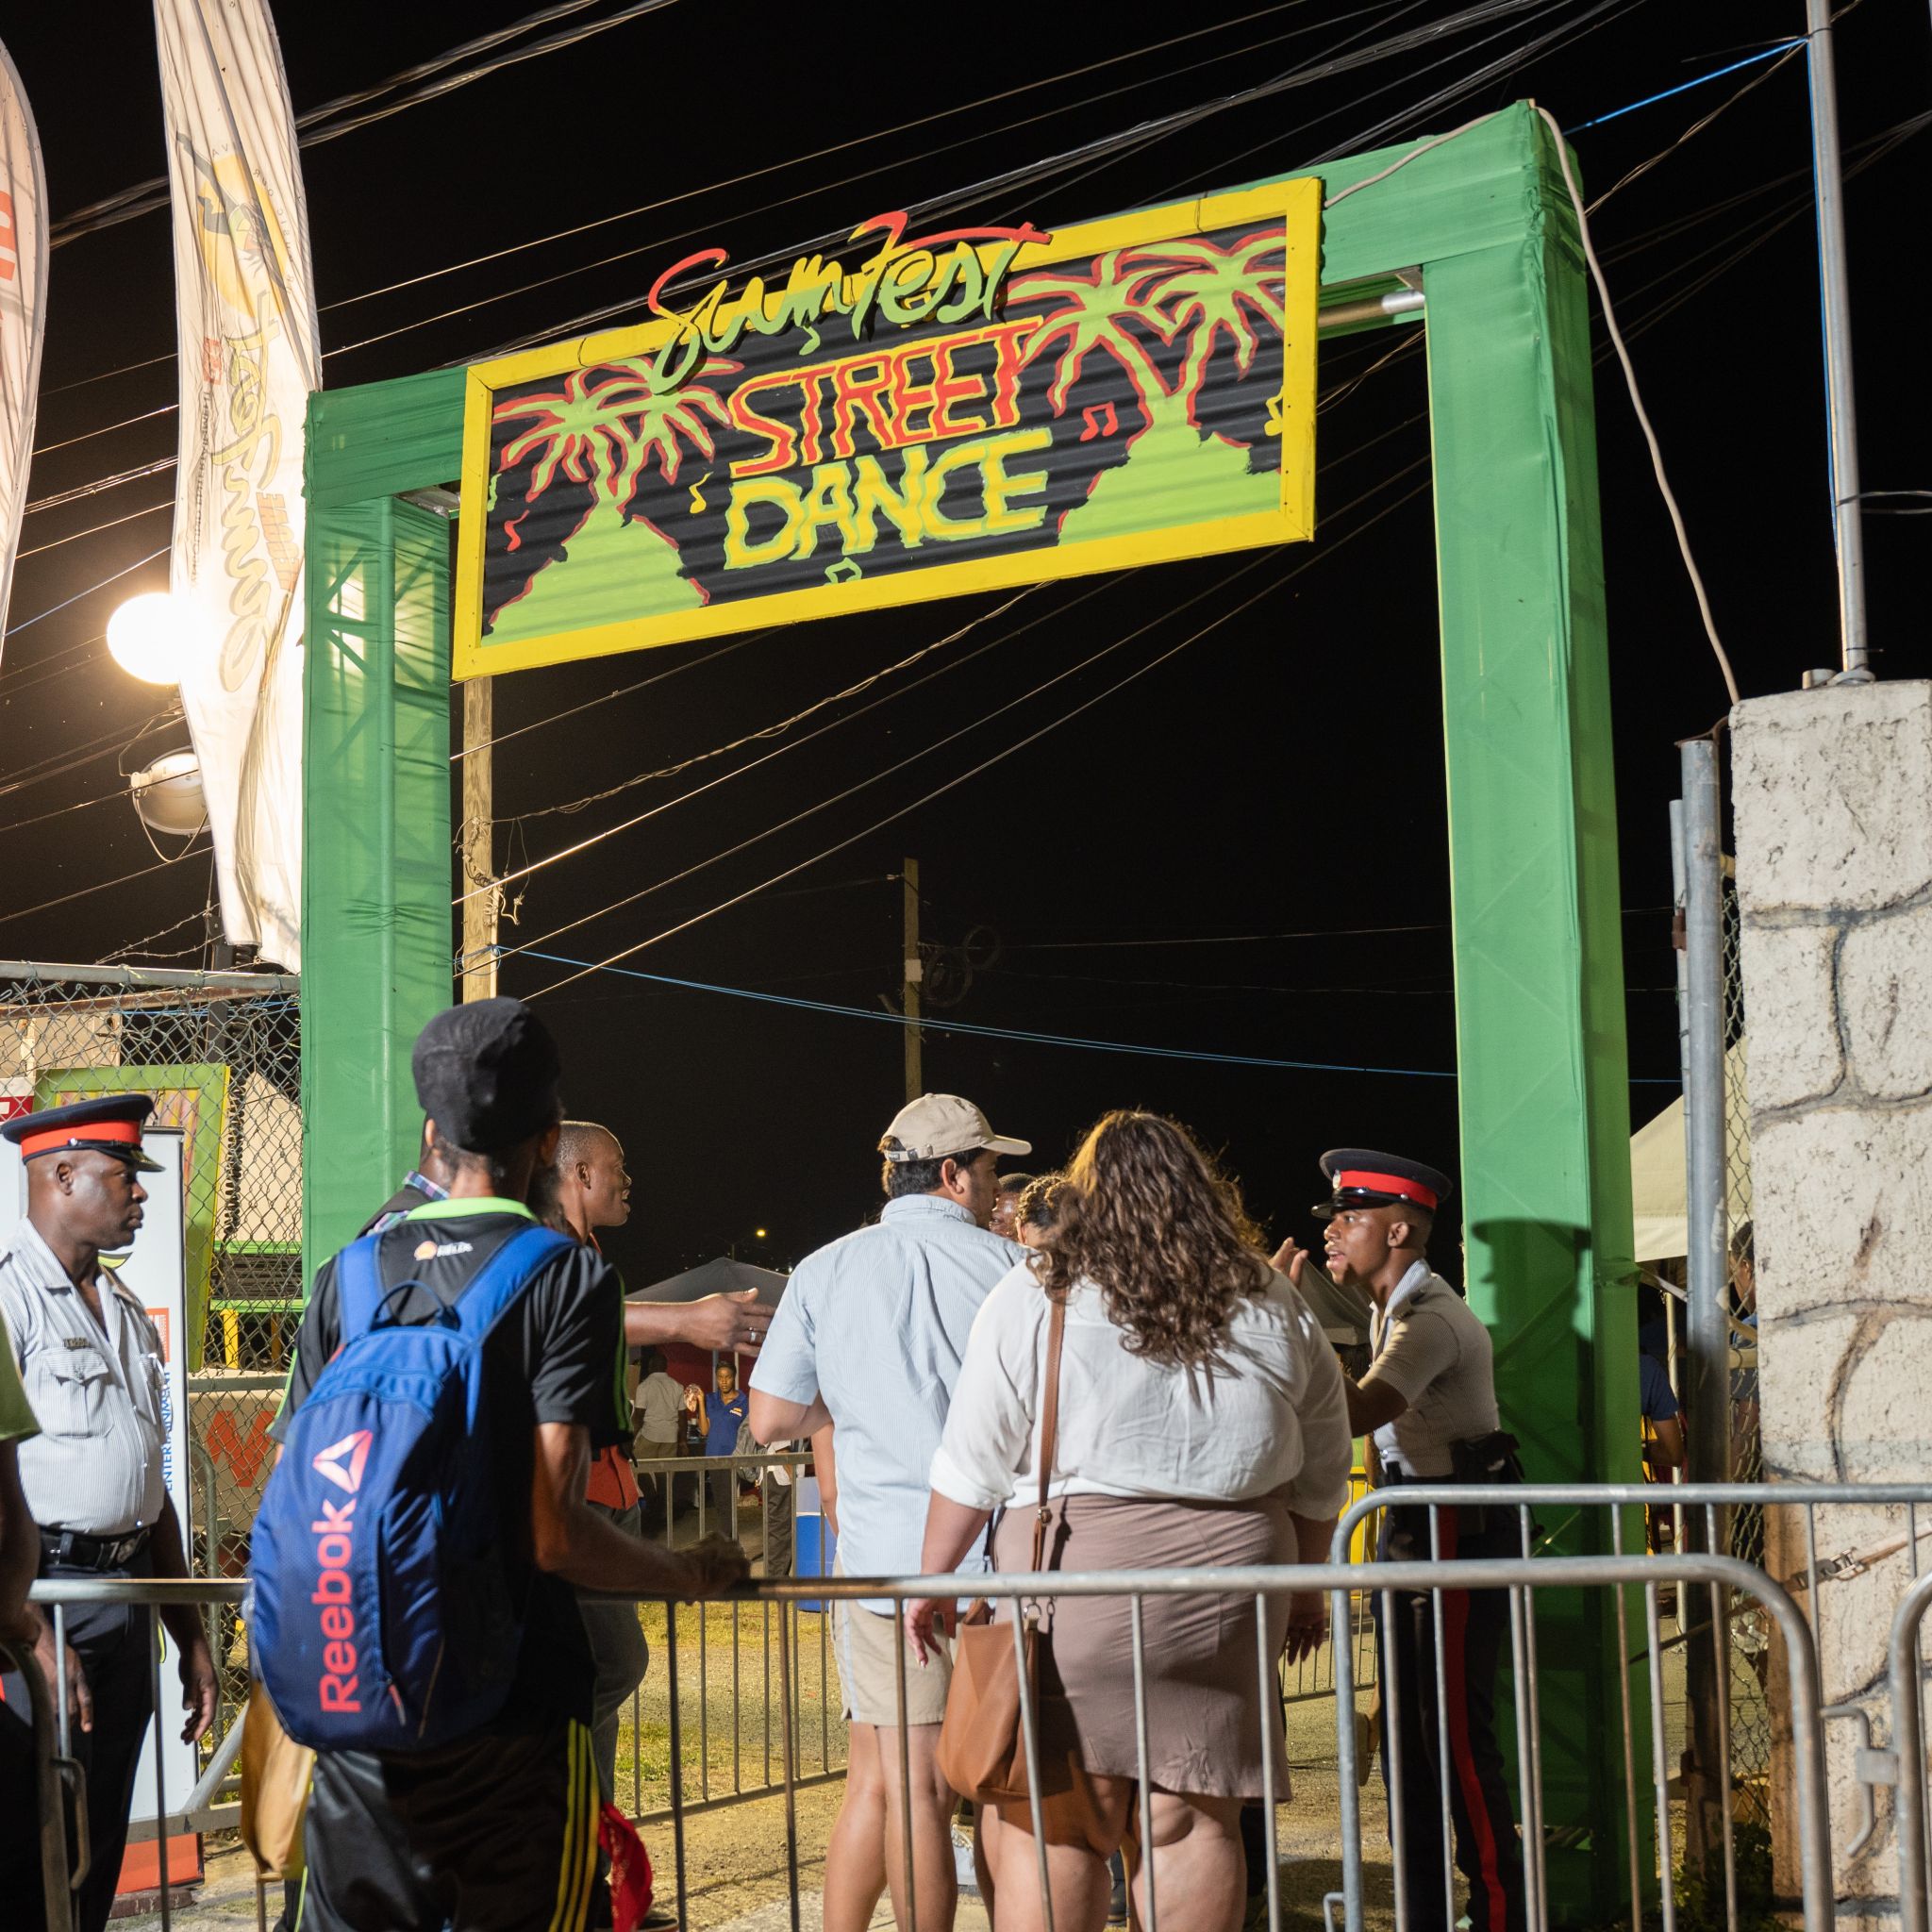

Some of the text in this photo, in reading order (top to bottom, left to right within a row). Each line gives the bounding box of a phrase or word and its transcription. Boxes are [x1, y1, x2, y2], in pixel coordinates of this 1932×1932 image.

[727, 315, 1043, 479] STREET
[724, 426, 1053, 571] DANCE
[311, 1497, 361, 1714] Reebok
